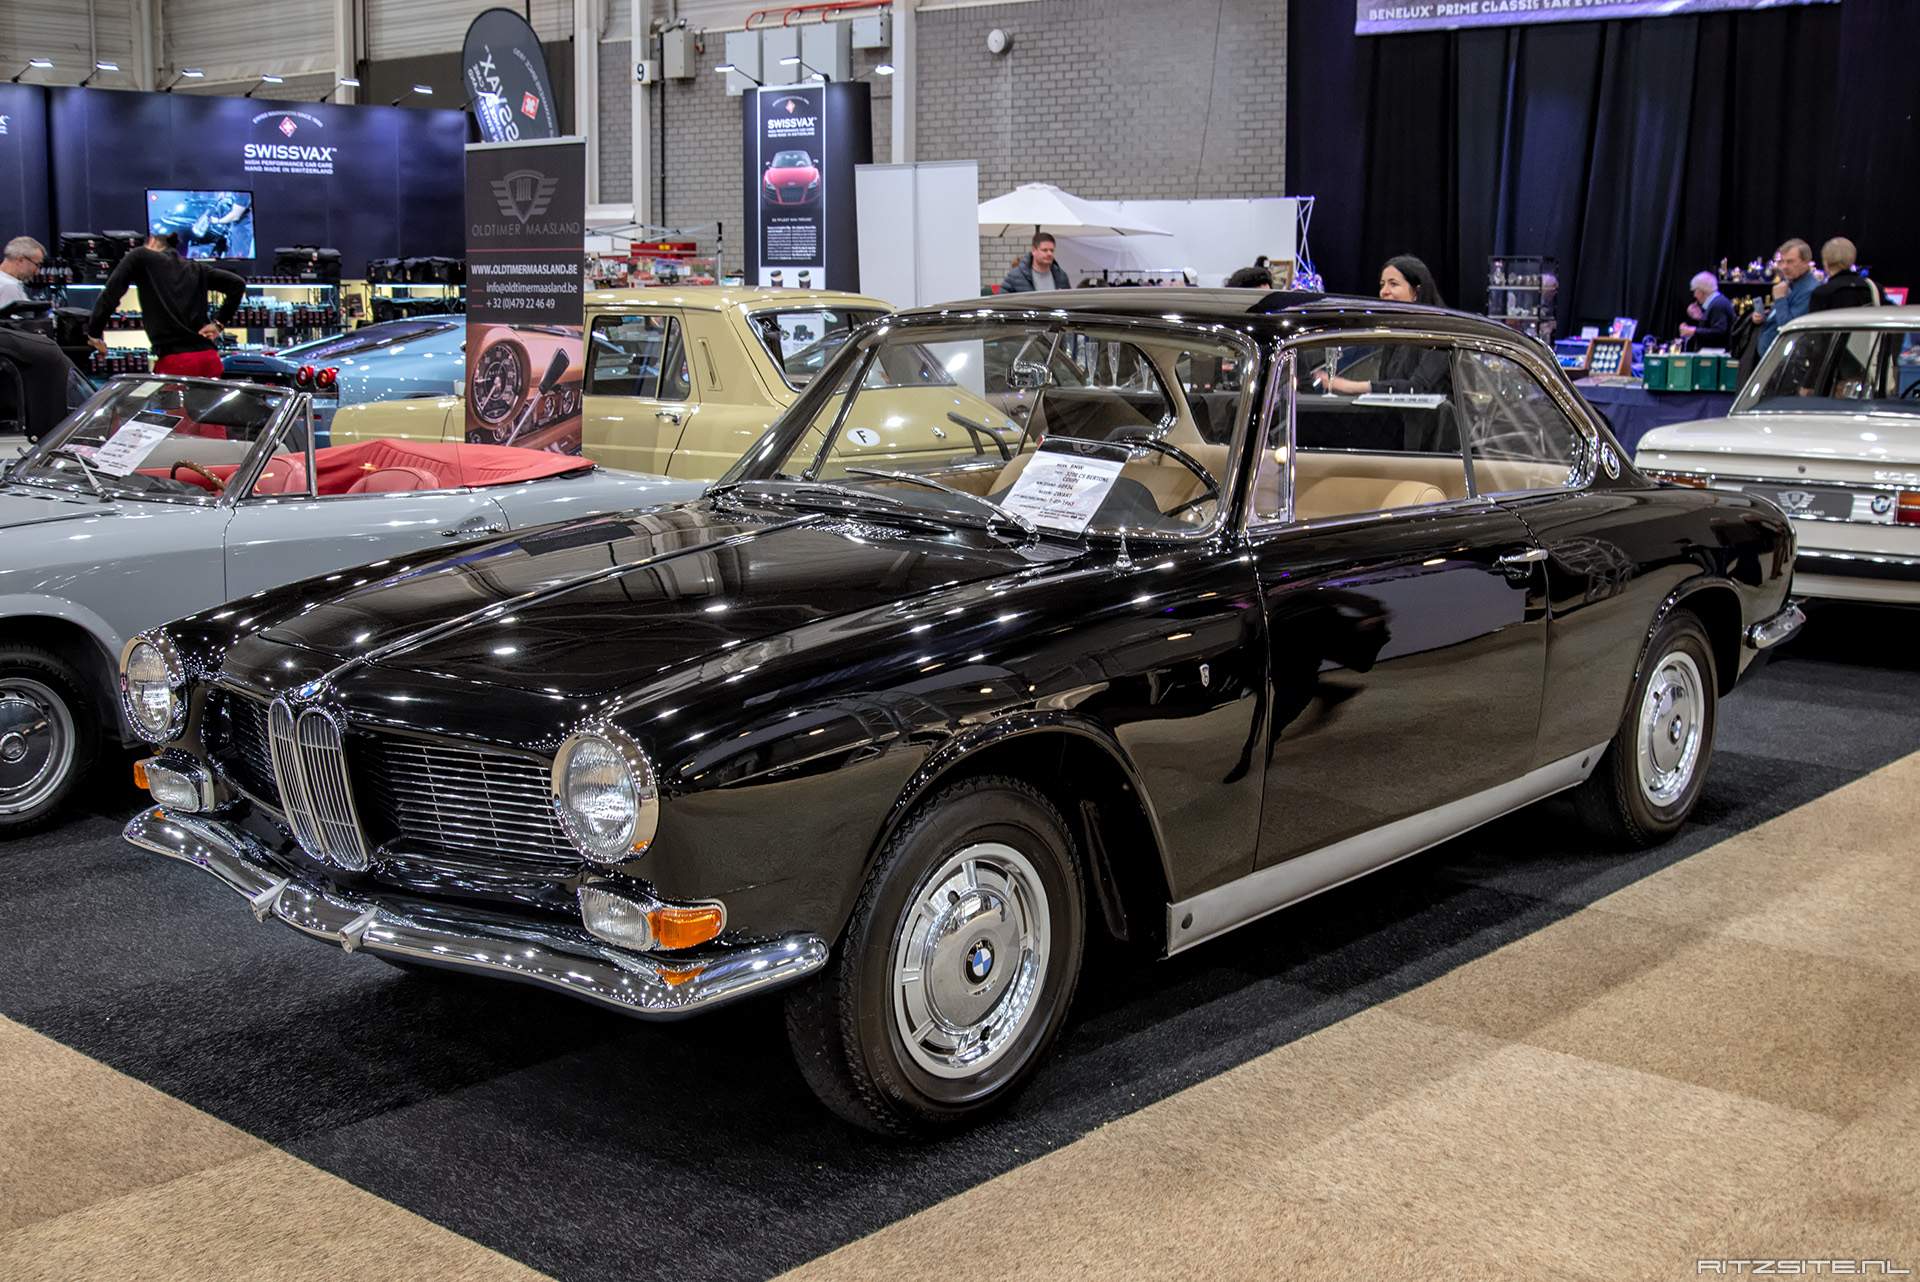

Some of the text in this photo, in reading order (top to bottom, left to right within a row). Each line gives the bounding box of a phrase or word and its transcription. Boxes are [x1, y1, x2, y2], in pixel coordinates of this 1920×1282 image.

[1437, 2, 1478, 16] PRIME
[1481, 0, 1540, 13] CLASSIC
[637, 63, 645, 82] 9
[472, 222, 580, 237] OLDTIMER MAASLAND
[471, 264, 578, 275] WWW.OLDTIMERMAASLAND.BE
[486, 282, 578, 295] info@oldtimermaasland.be
[493, 298, 501, 309] 32
[502, 298, 524, 310] (0)479
[526, 298, 534, 309] 22
[535, 298, 545, 309] 46
[546, 298, 556, 309] 49
[856, 430, 867, 444] F
